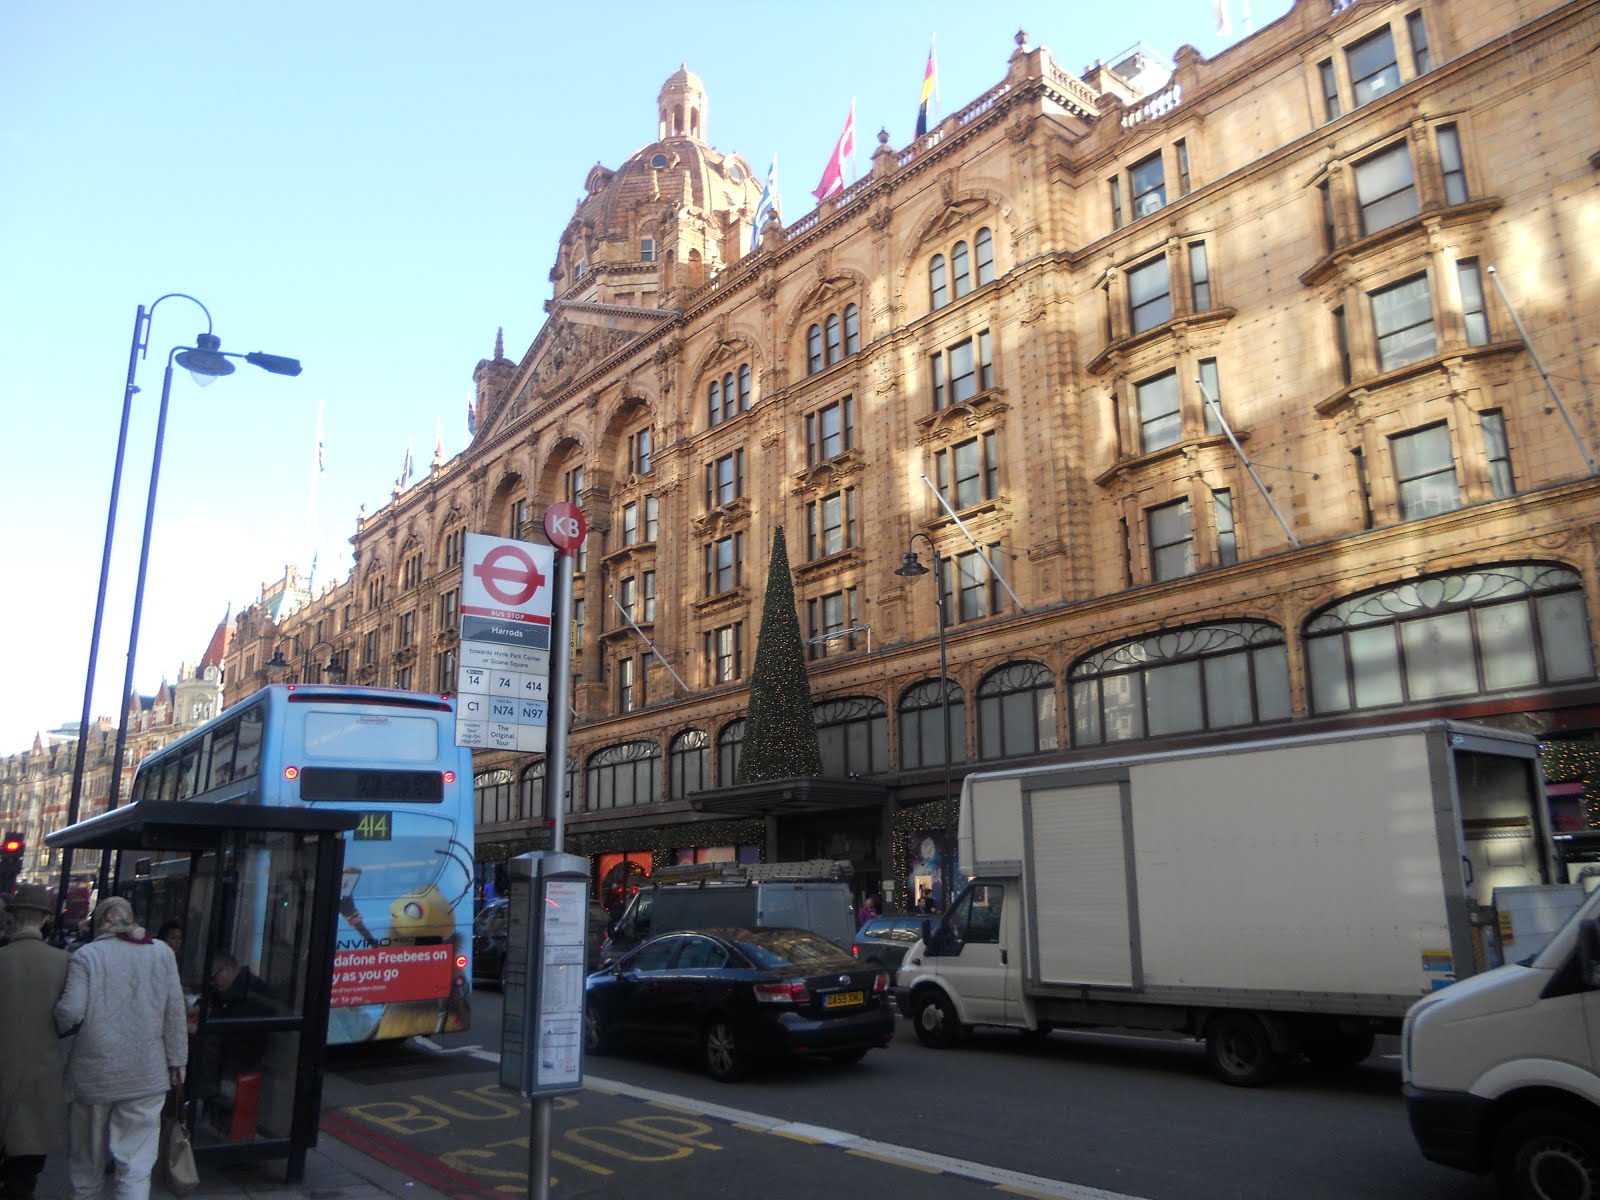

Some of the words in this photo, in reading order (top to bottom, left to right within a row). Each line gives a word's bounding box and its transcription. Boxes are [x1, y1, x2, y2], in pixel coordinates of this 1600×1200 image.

[551, 514, 580, 538] KB
[490, 610, 505, 618] BUS
[507, 612, 525, 620] STOP
[491, 626, 523, 638] Harrods
[469, 648, 492, 656] towards
[494, 650, 508, 659] Hyde
[510, 652, 521, 660] Park
[523, 654, 541, 662] Corner
[490, 658, 509, 666] Sloane
[510, 661, 529, 669] Square
[469, 675, 480, 685] 14
[499, 677, 511, 688] 74
[526, 681, 542, 691] 414
[467, 701, 479, 711] C1
[493, 705, 514, 716] N74
[522, 708, 544, 719] N97
[498, 724, 509, 732] The
[490, 731, 515, 740] Original
[355, 814, 388, 838] 414
[333, 953, 375, 967] dafone
[378, 950, 430, 964] Freebees
[432, 950, 448, 961] on
[342, 972, 357, 982] as
[358, 970, 381, 983] you
[383, 968, 399, 982] go
[438, 1115, 723, 1193] STOP
